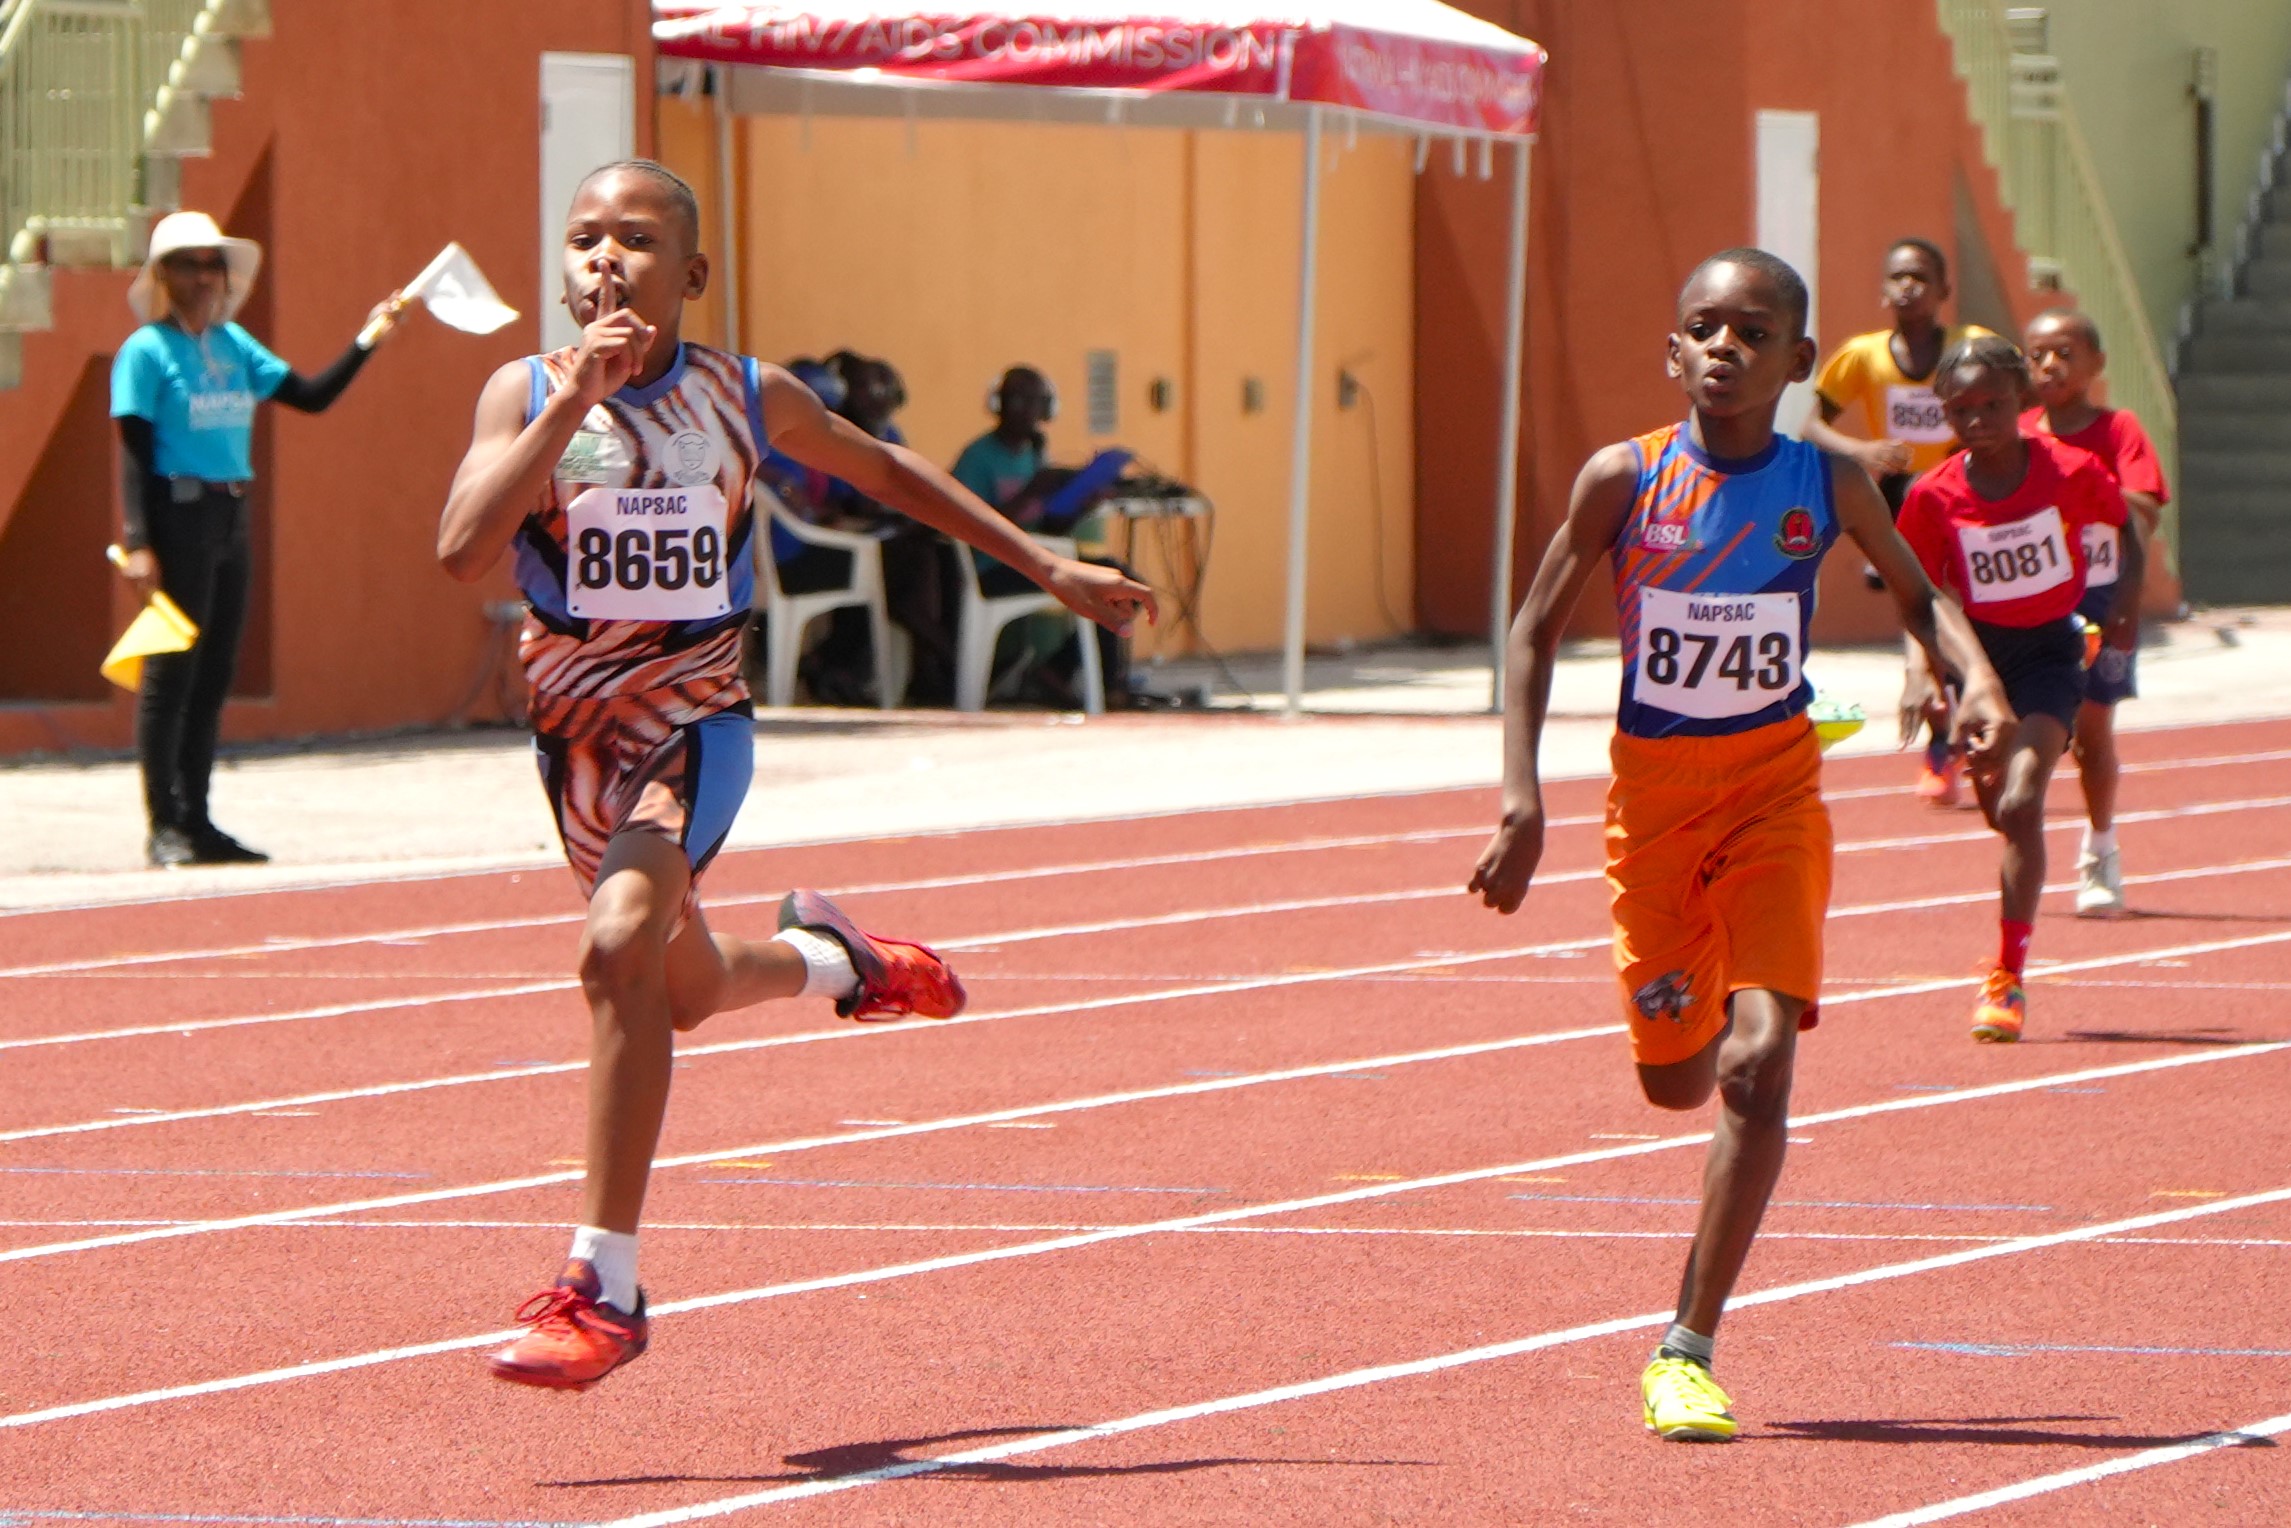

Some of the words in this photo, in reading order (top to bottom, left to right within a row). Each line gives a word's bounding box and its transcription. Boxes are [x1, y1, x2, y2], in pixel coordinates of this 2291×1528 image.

[972, 20, 1276, 70] COMMISSION
[616, 496, 687, 515] NAPSAC
[578, 526, 720, 591] 8659
[1644, 523, 1686, 546] BSL
[1971, 534, 2059, 585] 8081
[1688, 602, 1755, 622] NAPSAC
[1646, 627, 1791, 691] 8743
